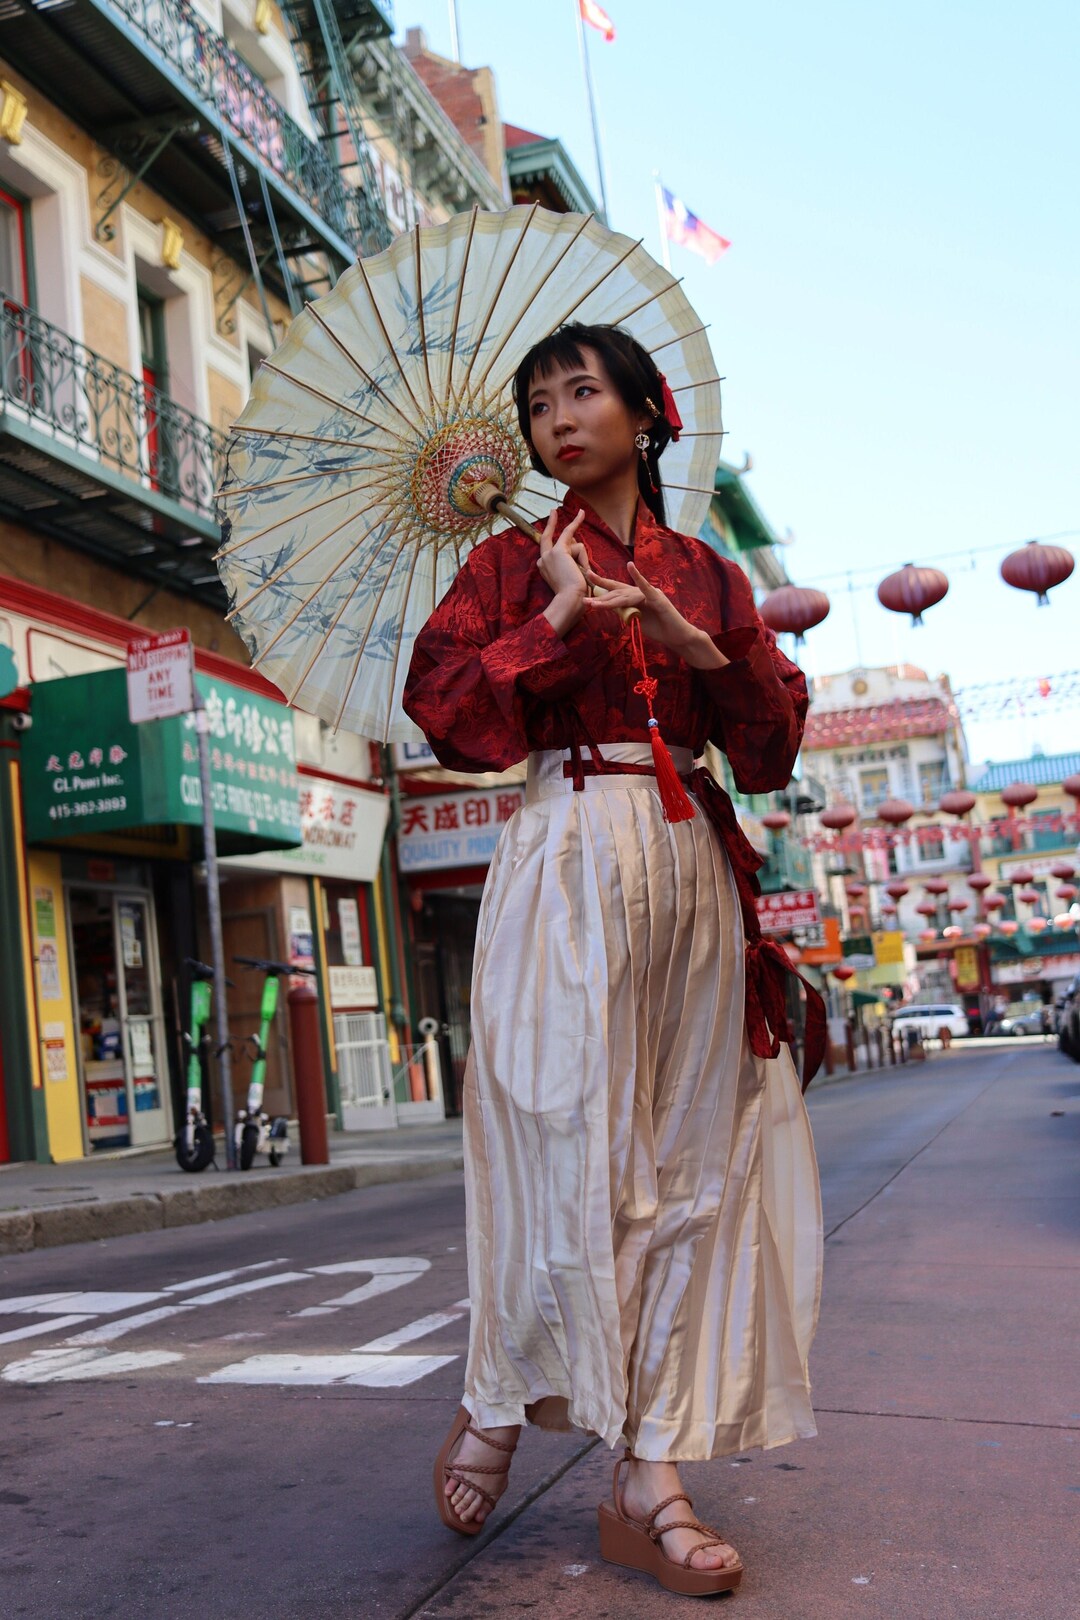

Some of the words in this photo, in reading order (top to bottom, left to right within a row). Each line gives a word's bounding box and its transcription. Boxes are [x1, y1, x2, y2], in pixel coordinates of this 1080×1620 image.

[129, 650, 147, 671] NO
[149, 646, 189, 665] STOPPING
[148, 667, 172, 684] ANY
[147, 684, 175, 700] TIME
[402, 838, 461, 864] QUALITY
